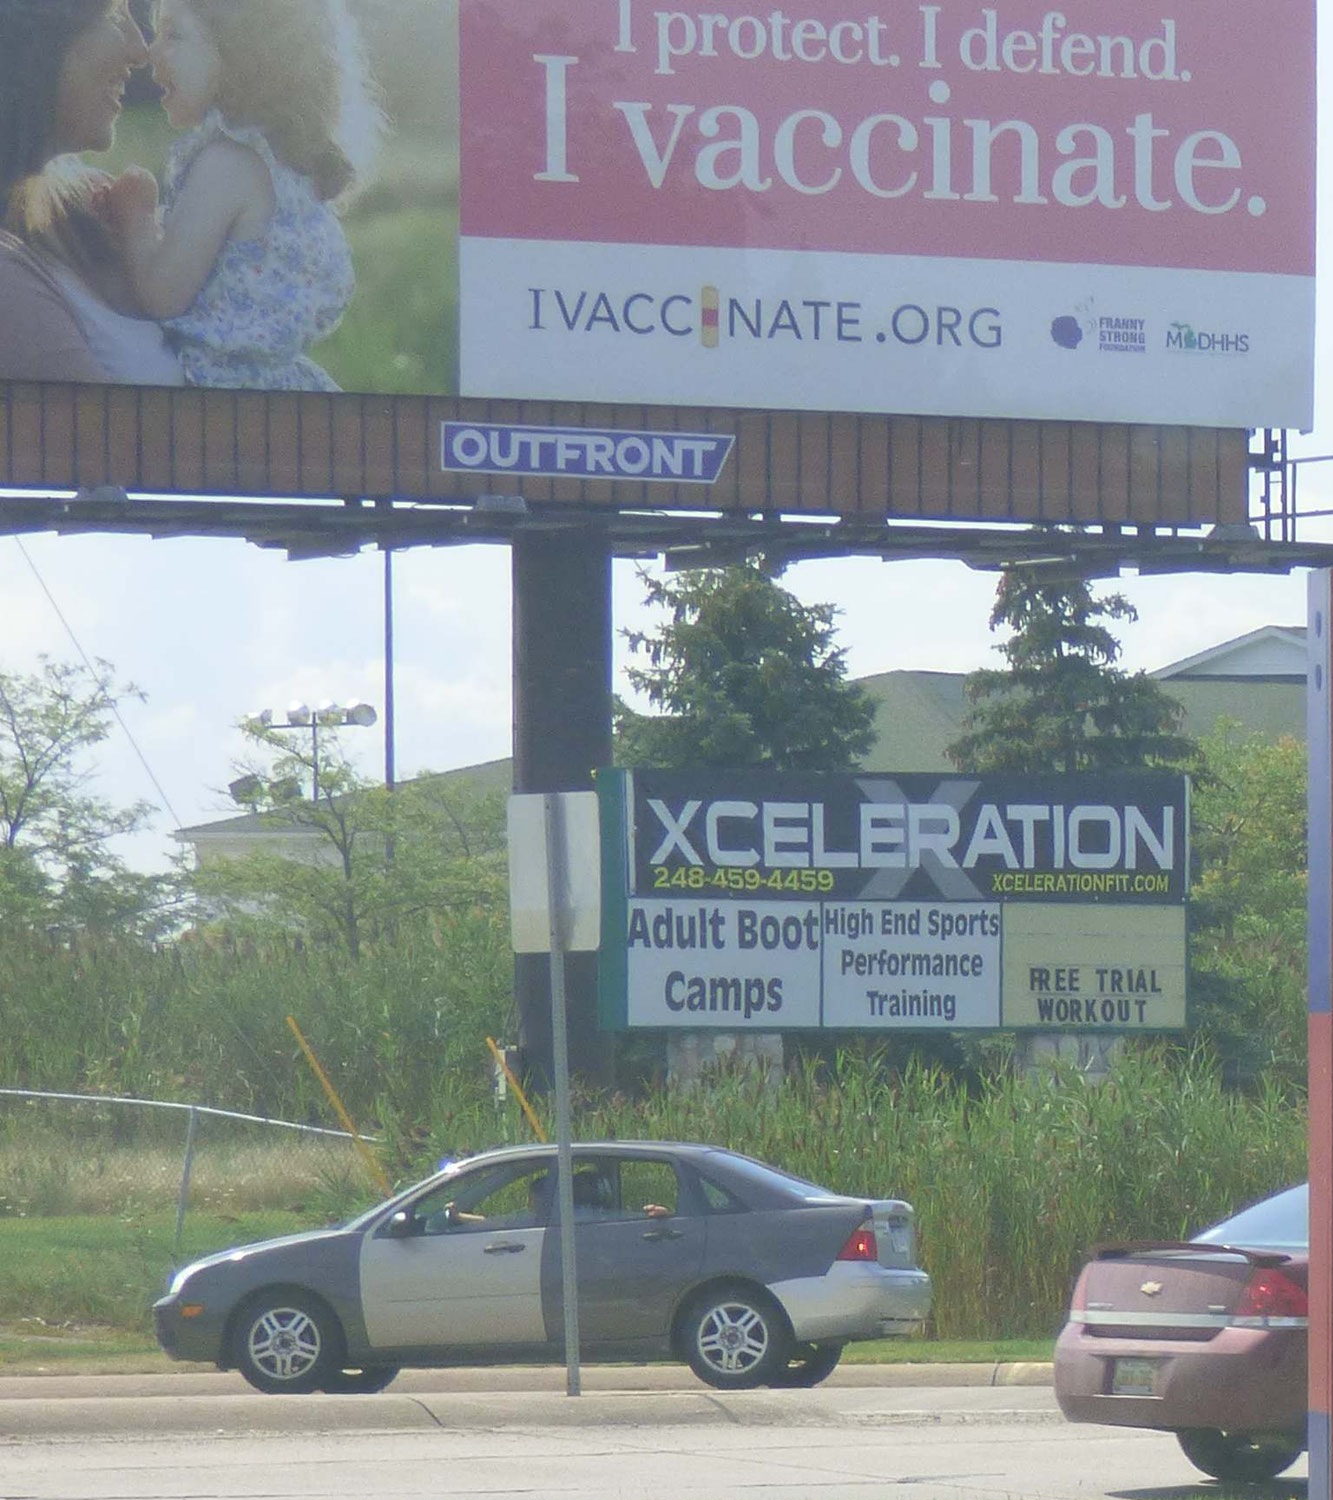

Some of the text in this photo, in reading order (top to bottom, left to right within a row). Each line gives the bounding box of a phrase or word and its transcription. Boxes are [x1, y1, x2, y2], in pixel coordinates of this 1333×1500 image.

[612, 0, 1192, 83] I protect. I defend.
[532, 54, 1268, 218] I vaccinate.
[1099, 316, 1146, 331] FRANNY
[1099, 330, 1146, 345] STRONG
[451, 429, 718, 478] OUTFRONT
[647, 799, 1175, 870] XCELERATION
[653, 866, 834, 892] 248-459-4459
[992, 873, 1169, 894] XCELERATIONFIT.COM
[627, 907, 820, 951] Adult Boot
[824, 908, 999, 941] High End Sports
[841, 949, 984, 977] Performance
[664, 970, 783, 1019] Camps
[1029, 967, 1162, 993] FREE TRIAL
[866, 989, 957, 1021] Training
[1037, 998, 1148, 1022] WORKOUT
